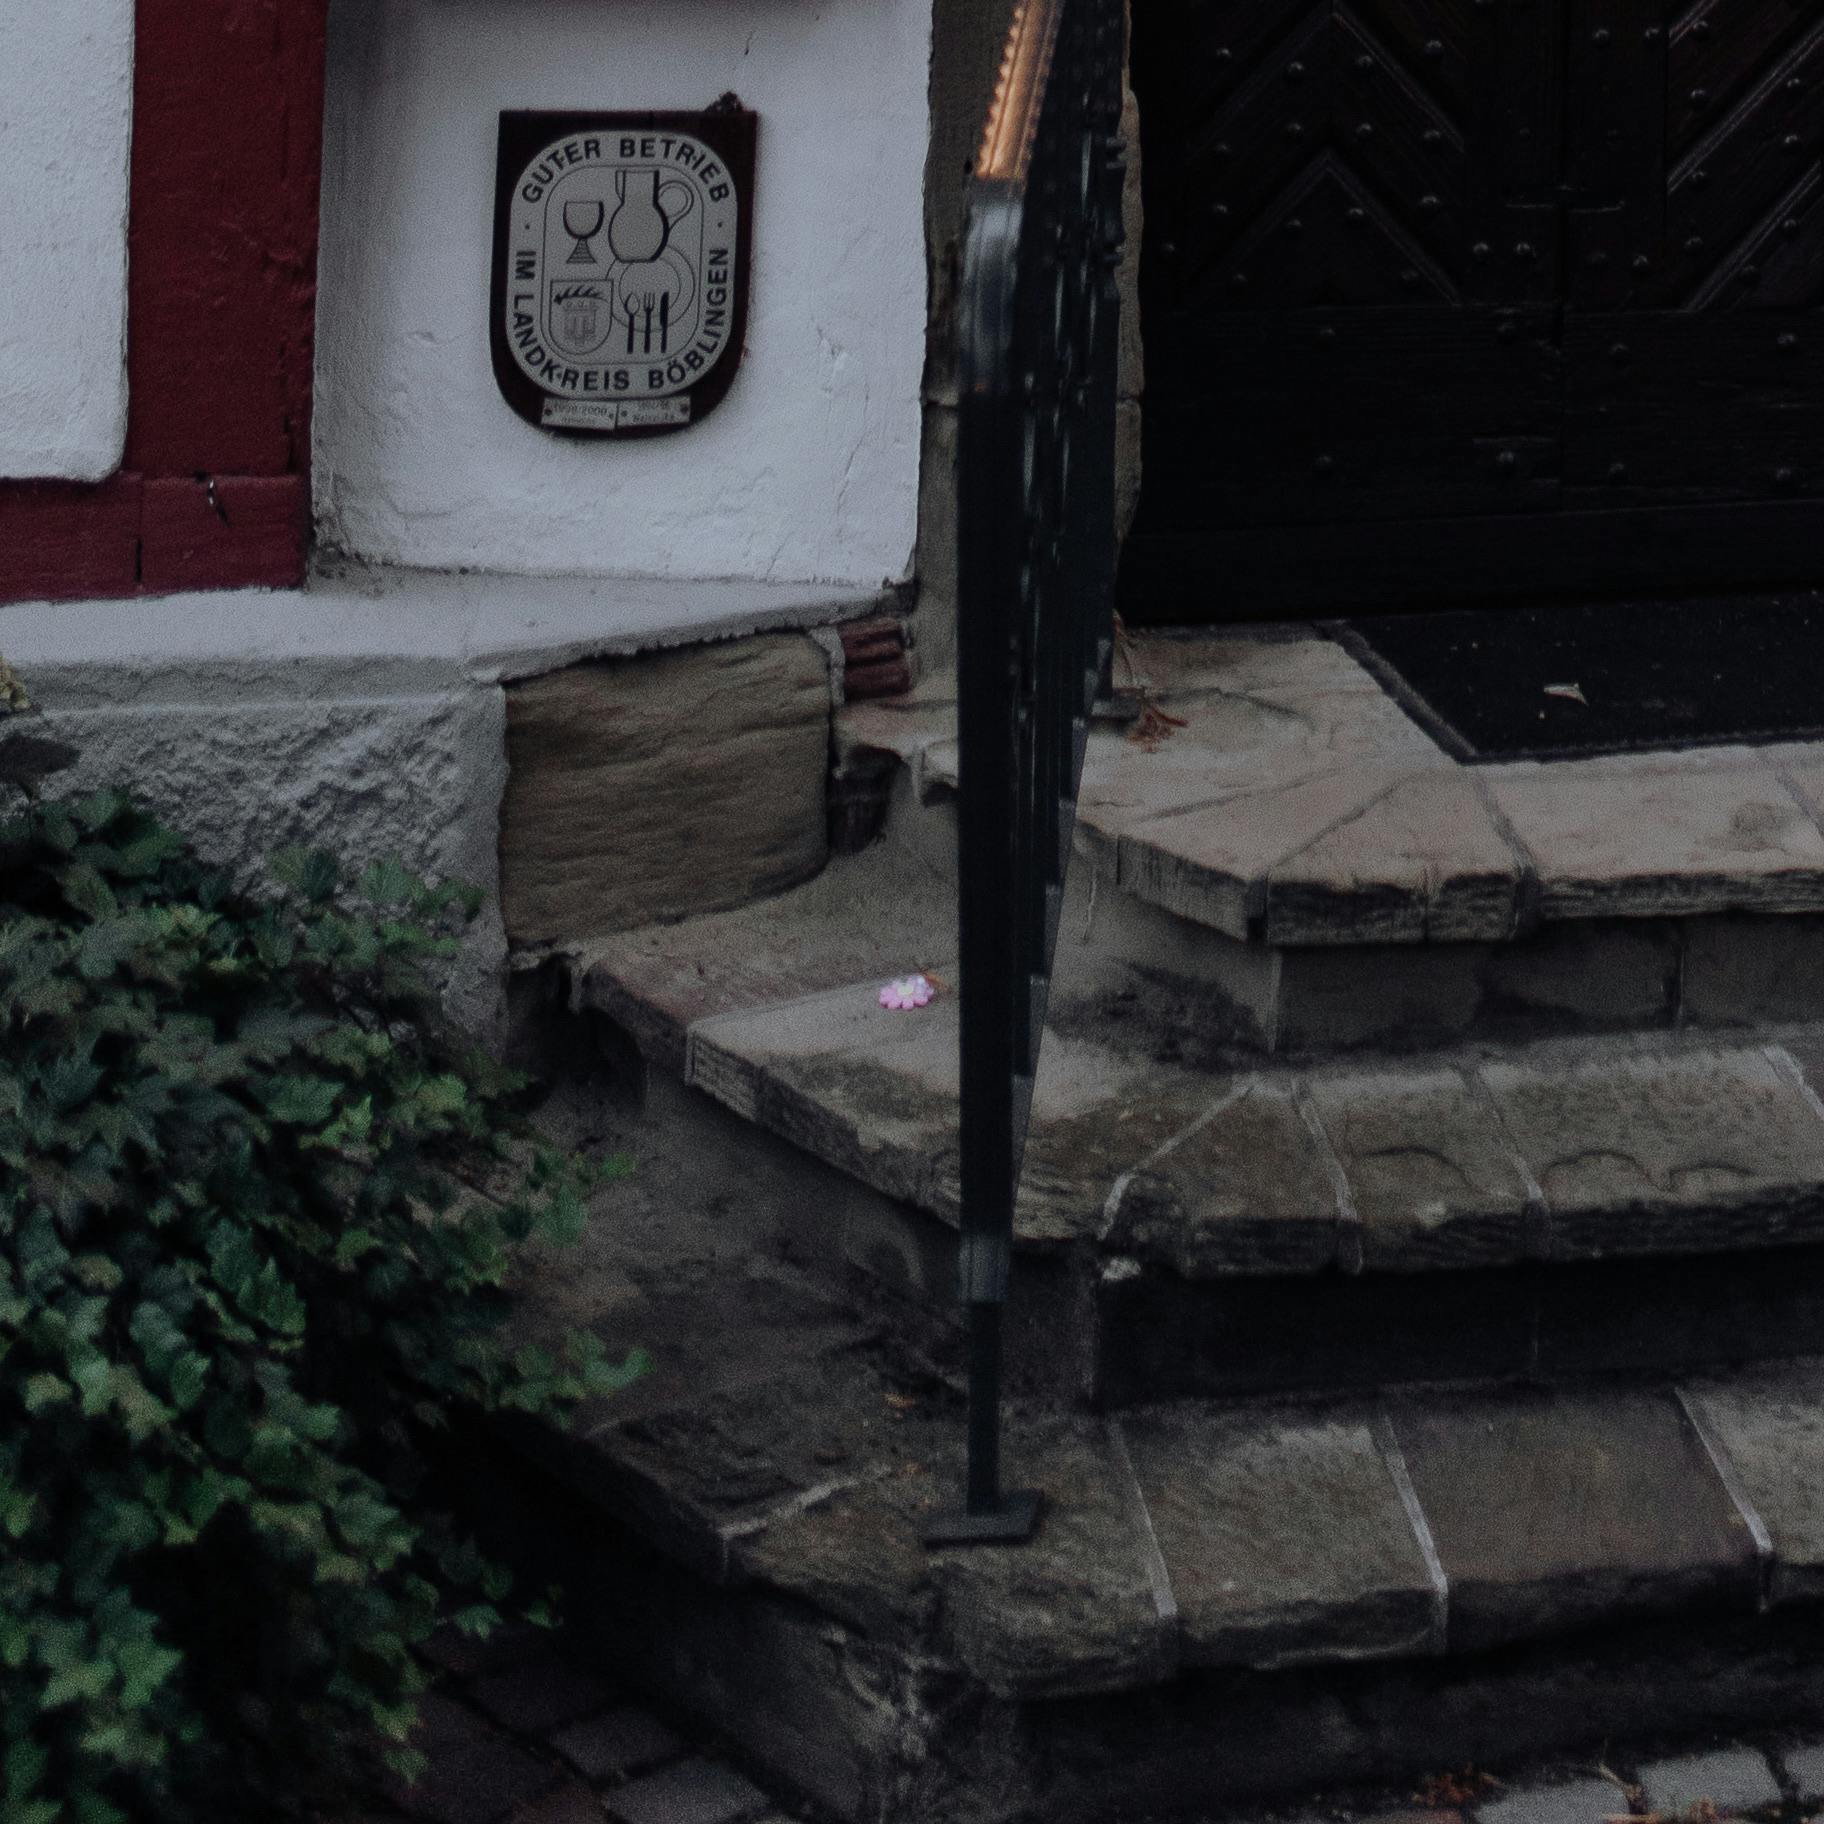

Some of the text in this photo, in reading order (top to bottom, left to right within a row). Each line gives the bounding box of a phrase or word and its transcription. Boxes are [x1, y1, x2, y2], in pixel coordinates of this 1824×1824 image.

[521, 137, 731, 203] GUTER BETRIEB
[512, 248, 729, 392] IM LANDKREIS BÖBLINGEN
